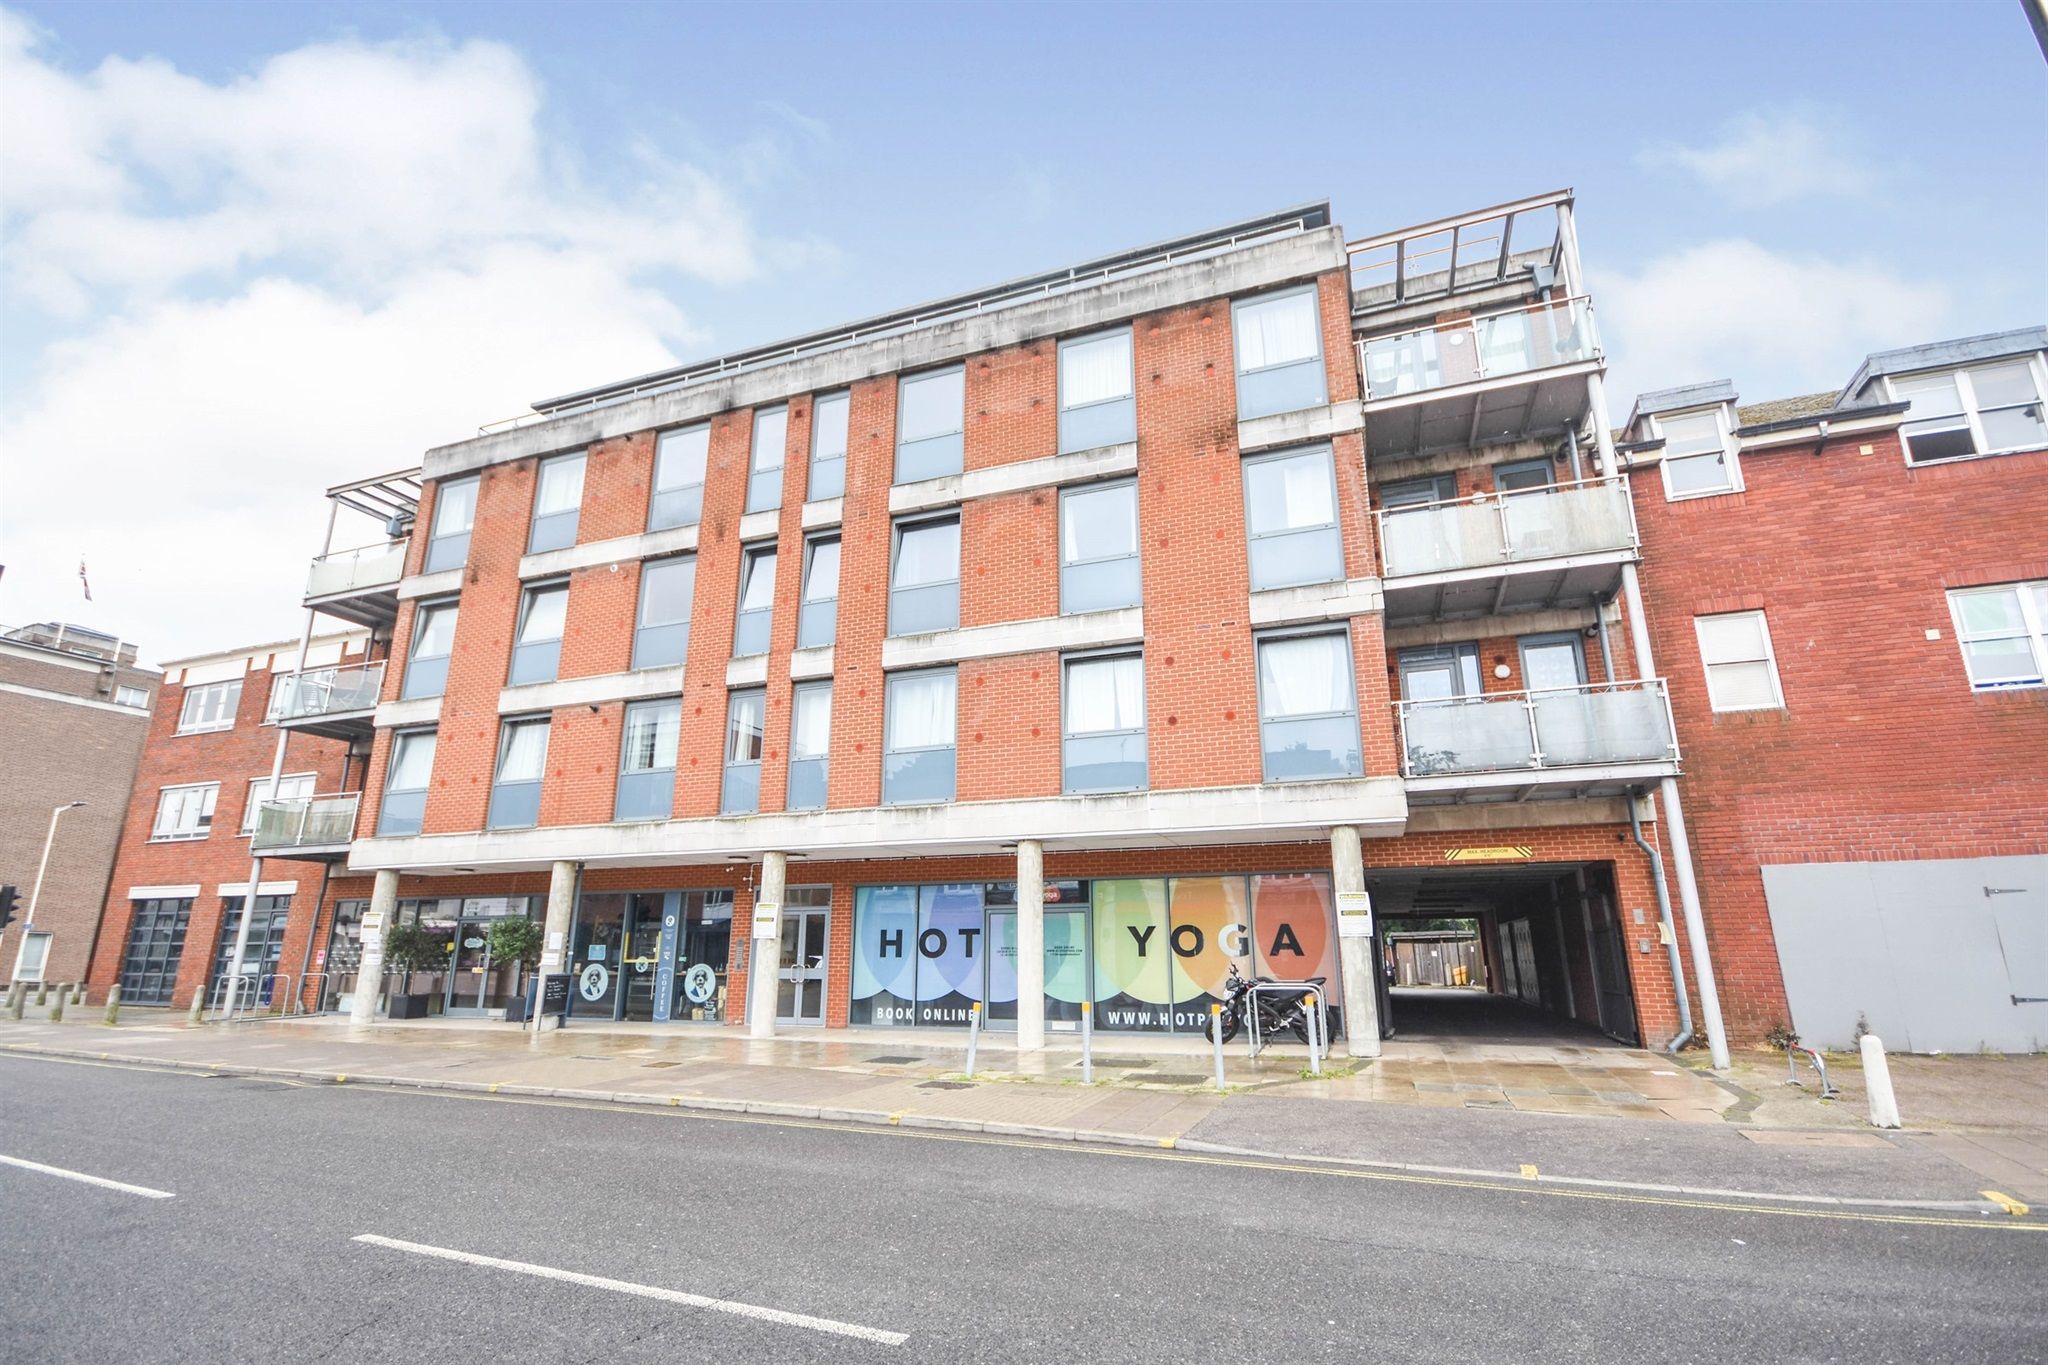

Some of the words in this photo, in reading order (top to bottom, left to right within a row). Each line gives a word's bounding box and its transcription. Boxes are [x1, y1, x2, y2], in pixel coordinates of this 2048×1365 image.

[879, 928, 981, 959] HOT
[1127, 923, 1305, 958] YOGA
[660, 974, 668, 1011] COFFEE
[876, 1007, 914, 1020] BOOK
[923, 1008, 974, 1021] ONLINE
